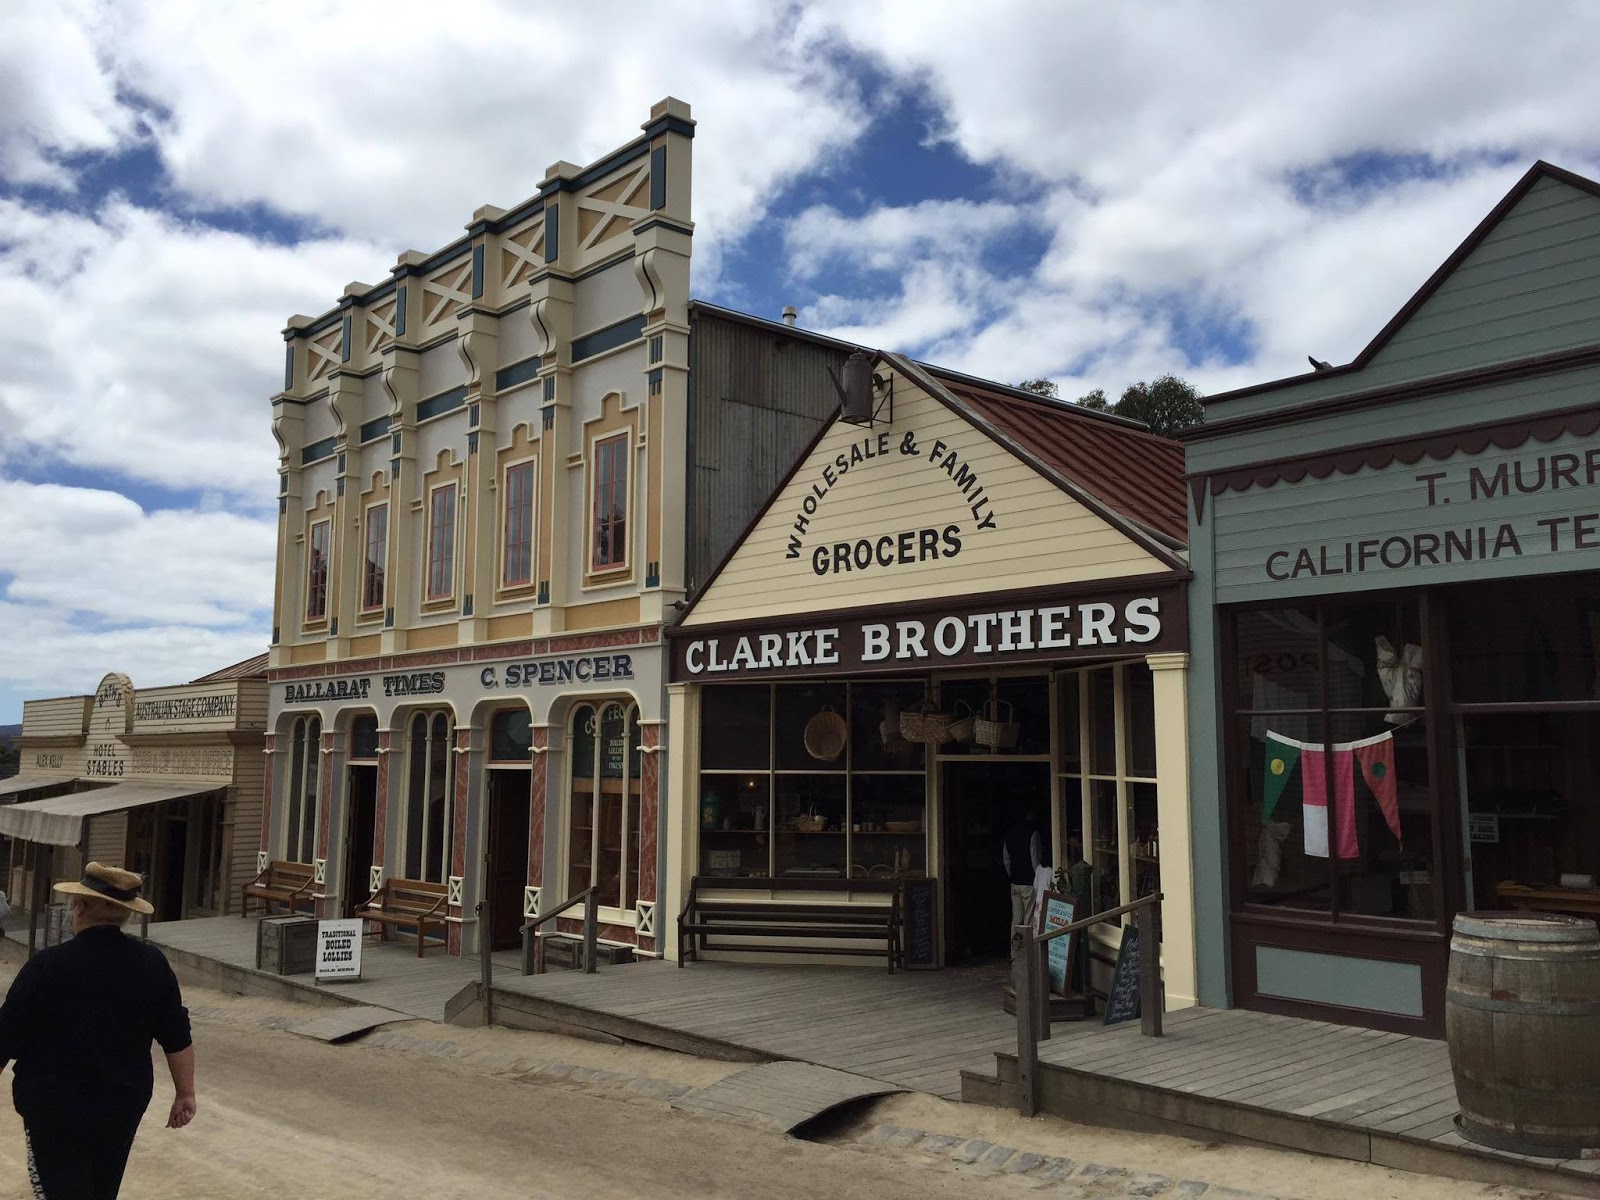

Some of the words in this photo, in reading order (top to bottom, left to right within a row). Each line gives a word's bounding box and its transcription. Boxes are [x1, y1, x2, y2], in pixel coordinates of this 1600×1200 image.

[785, 431, 890, 560] WHOLESALE
[899, 430, 920, 456] &
[928, 439, 998, 532] FAMILY
[1415, 472, 1451, 506] T.
[812, 523, 963, 576] GROCERS
[1265, 523, 1523, 581] CALIFORNIA
[685, 628, 839, 675] CLARKE
[861, 596, 1163, 663] BROTHERS
[285, 678, 370, 703] BALLARAT
[382, 671, 446, 698] TIMES
[480, 666, 499, 690] C.
[505, 654, 634, 687] SPENCER
[93, 744, 116, 757] HOTEL
[608, 747, 625, 755] LOLLIE
[86, 760, 124, 776] STABLES
[322, 930, 356, 938] TRADITIONAL
[325, 939, 351, 950] BOILED
[322, 951, 353, 962] LOLLIES
